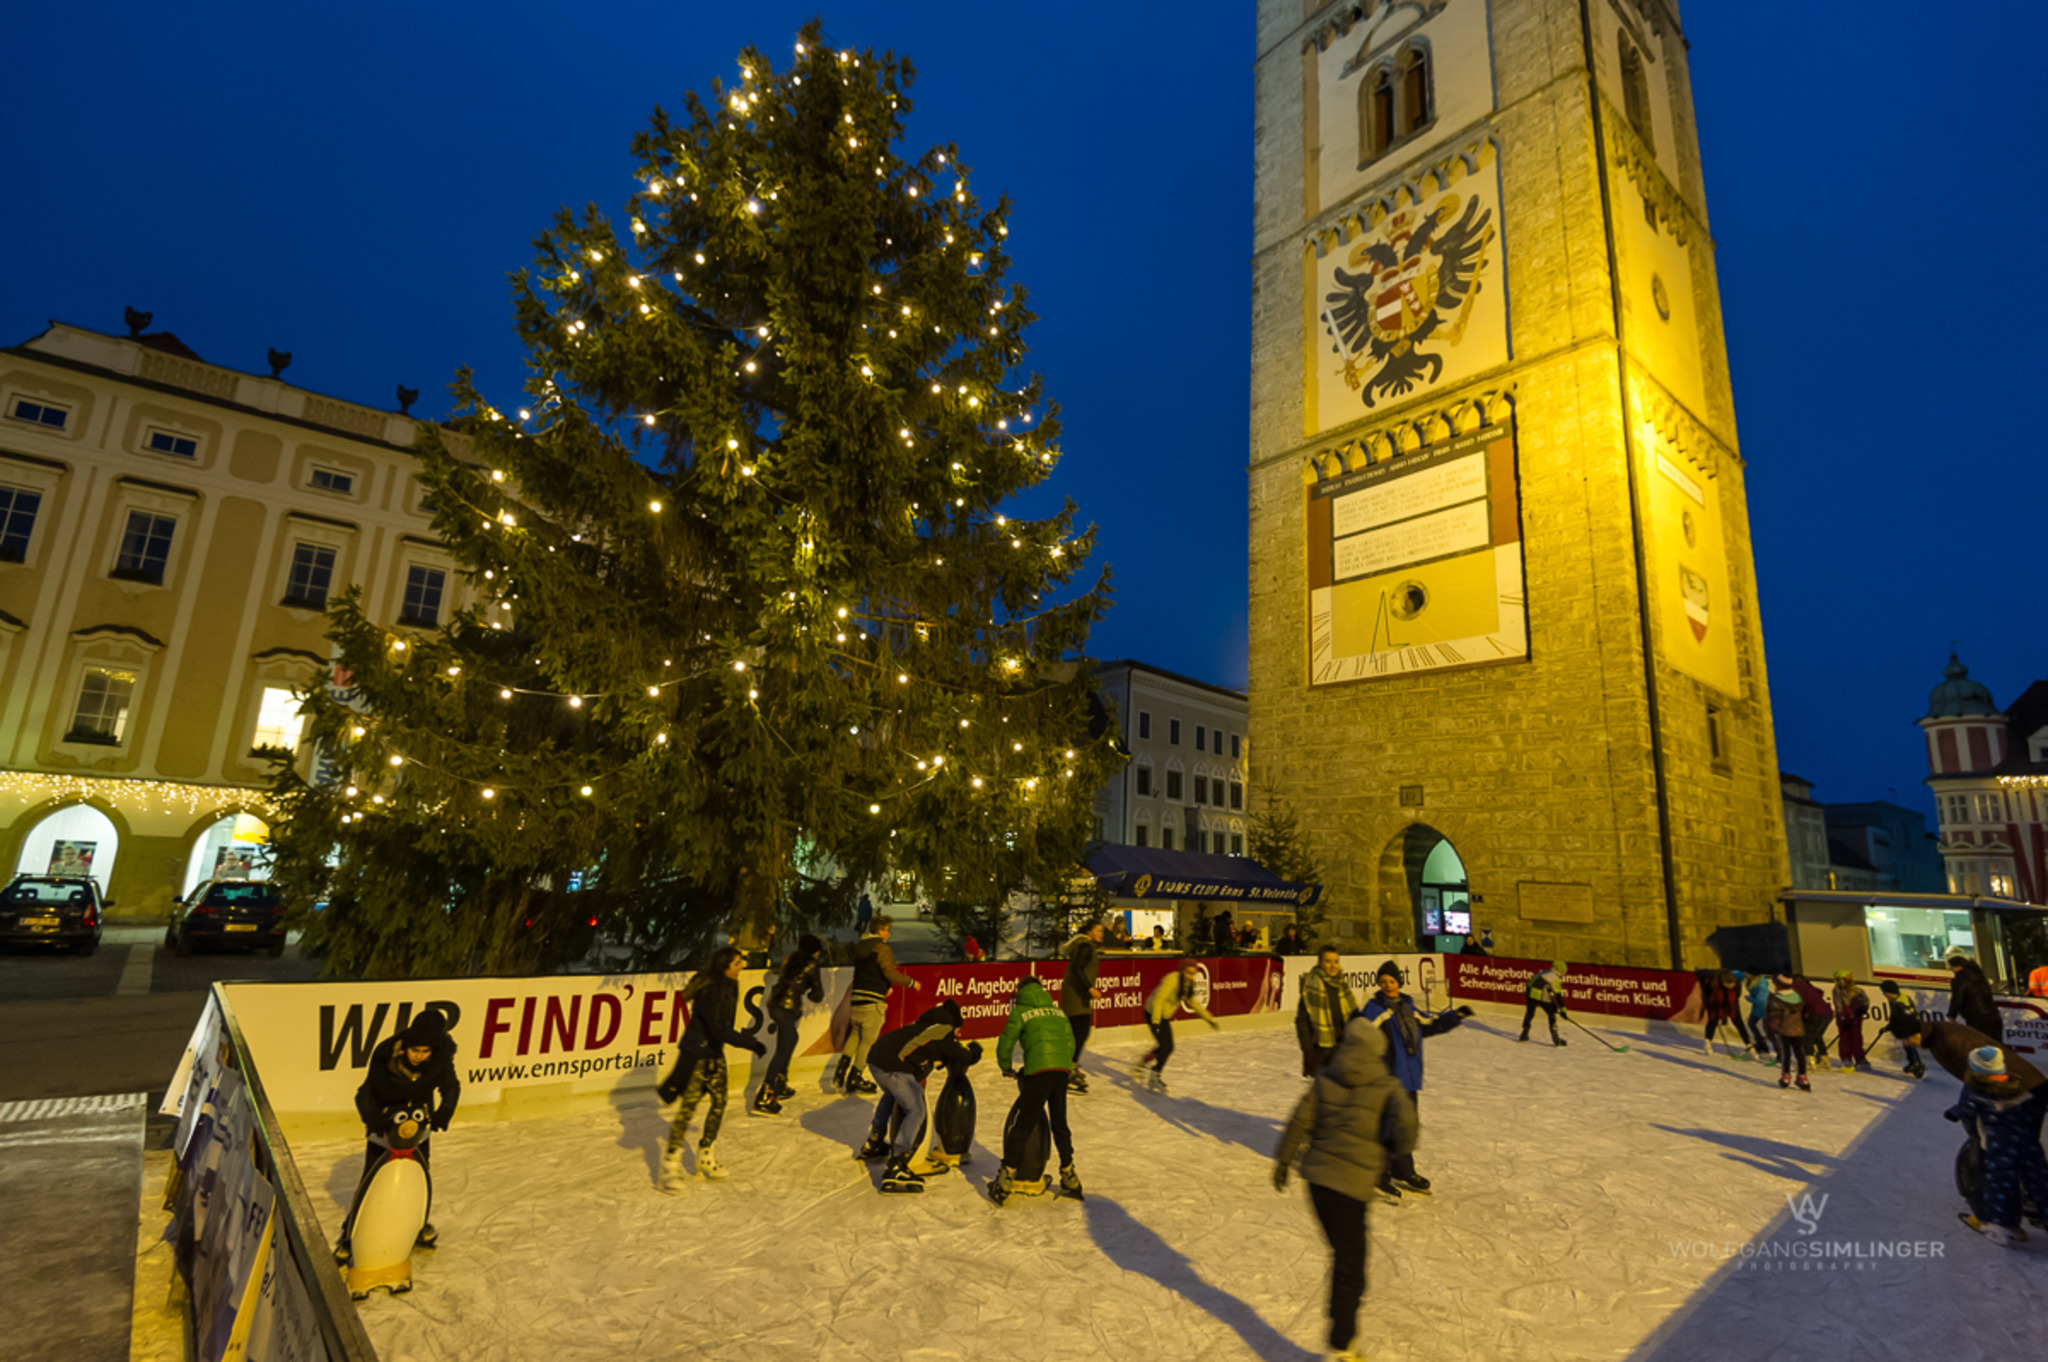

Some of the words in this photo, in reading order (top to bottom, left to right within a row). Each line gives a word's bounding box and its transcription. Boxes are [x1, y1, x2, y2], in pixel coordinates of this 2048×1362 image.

[1156, 880, 1192, 894] LIONS
[1219, 884, 1244, 897] Enns
[935, 977, 963, 997] Alle
[965, 976, 1020, 999] Angebot
[1122, 972, 1141, 987] und
[1459, 963, 1480, 975] Alle
[1482, 965, 1534, 980] Angebote
[1642, 980, 1667, 992] und
[1114, 992, 1142, 1008] Klick!
[1572, 988, 1592, 1000] auf
[1595, 990, 1630, 1004] einen
[1633, 993, 1671, 1008] Klick!
[2014, 1019, 2048, 1030] enn
[2006, 1029, 2048, 1040] porta
[468, 1049, 666, 1084] www.ennsportal.at
